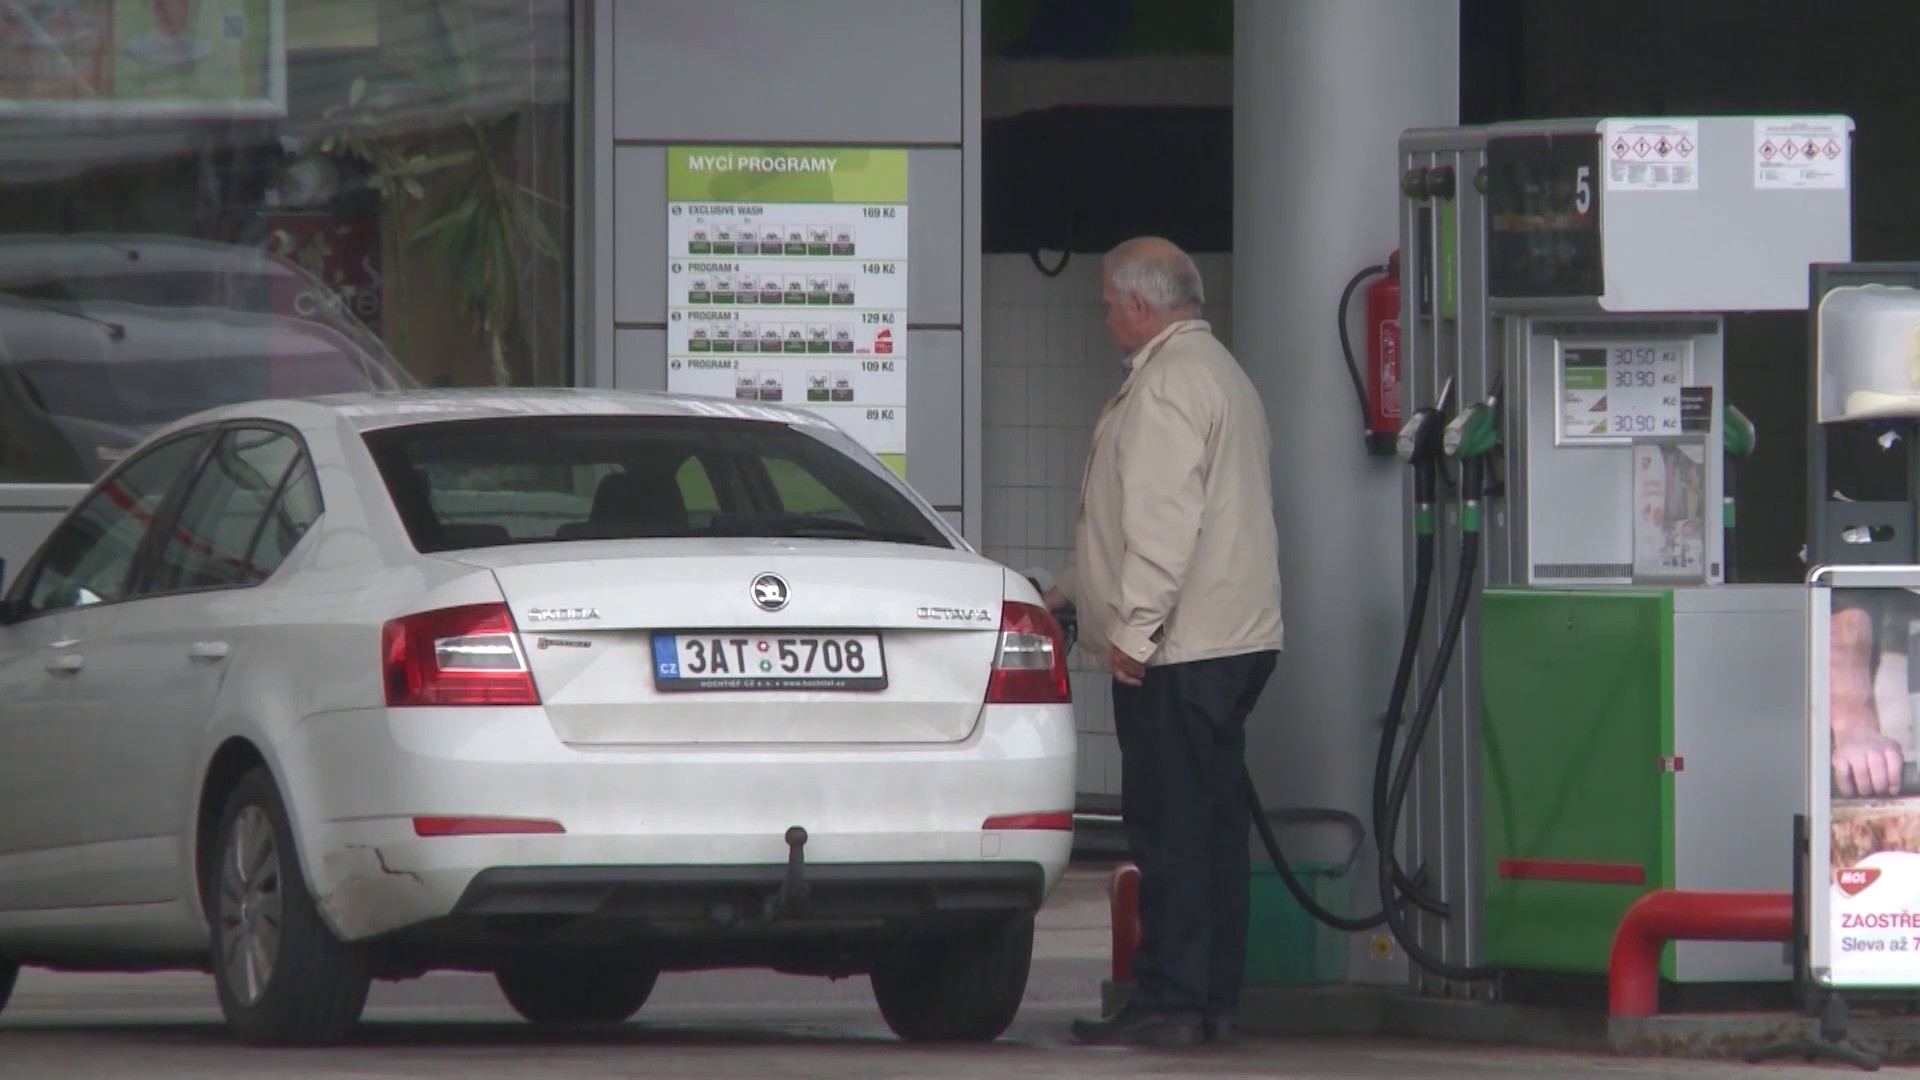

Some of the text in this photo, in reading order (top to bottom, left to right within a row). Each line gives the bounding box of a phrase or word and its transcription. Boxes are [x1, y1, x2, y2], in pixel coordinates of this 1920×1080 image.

[688, 153, 837, 172] MYCÍ PROGRAMY
[1575, 166, 1591, 214] 5
[688, 206, 735, 216] EXCLUSIVE
[737, 206, 764, 216] WASH
[883, 207, 896, 218] Kč
[688, 263, 732, 273] PROGRAM
[734, 263, 740, 273] 4
[862, 263, 895, 274] 149 Kč
[688, 311, 732, 321] PROGRAM
[734, 311, 739, 321] 3
[862, 313, 895, 324] 129 Kč
[1615, 350, 1677, 365] 30.50 Kč
[688, 360, 731, 370] PROGRAM
[733, 360, 739, 370] 2
[861, 361, 894, 372] 109 Kč
[1615, 371, 1677, 387] 30.90 Kč
[1662, 396, 1677, 406] Kč
[866, 409, 894, 420] 89 Kč
[1615, 415, 1656, 432] 30.90
[1662, 418, 1677, 429] Kč
[685, 639, 865, 674] 3AT 5708
[660, 664, 677, 675] CZ
[1841, 872, 1867, 884] MOL
[1841, 936, 1885, 952] Sleva
[1889, 936, 1908, 952] až
